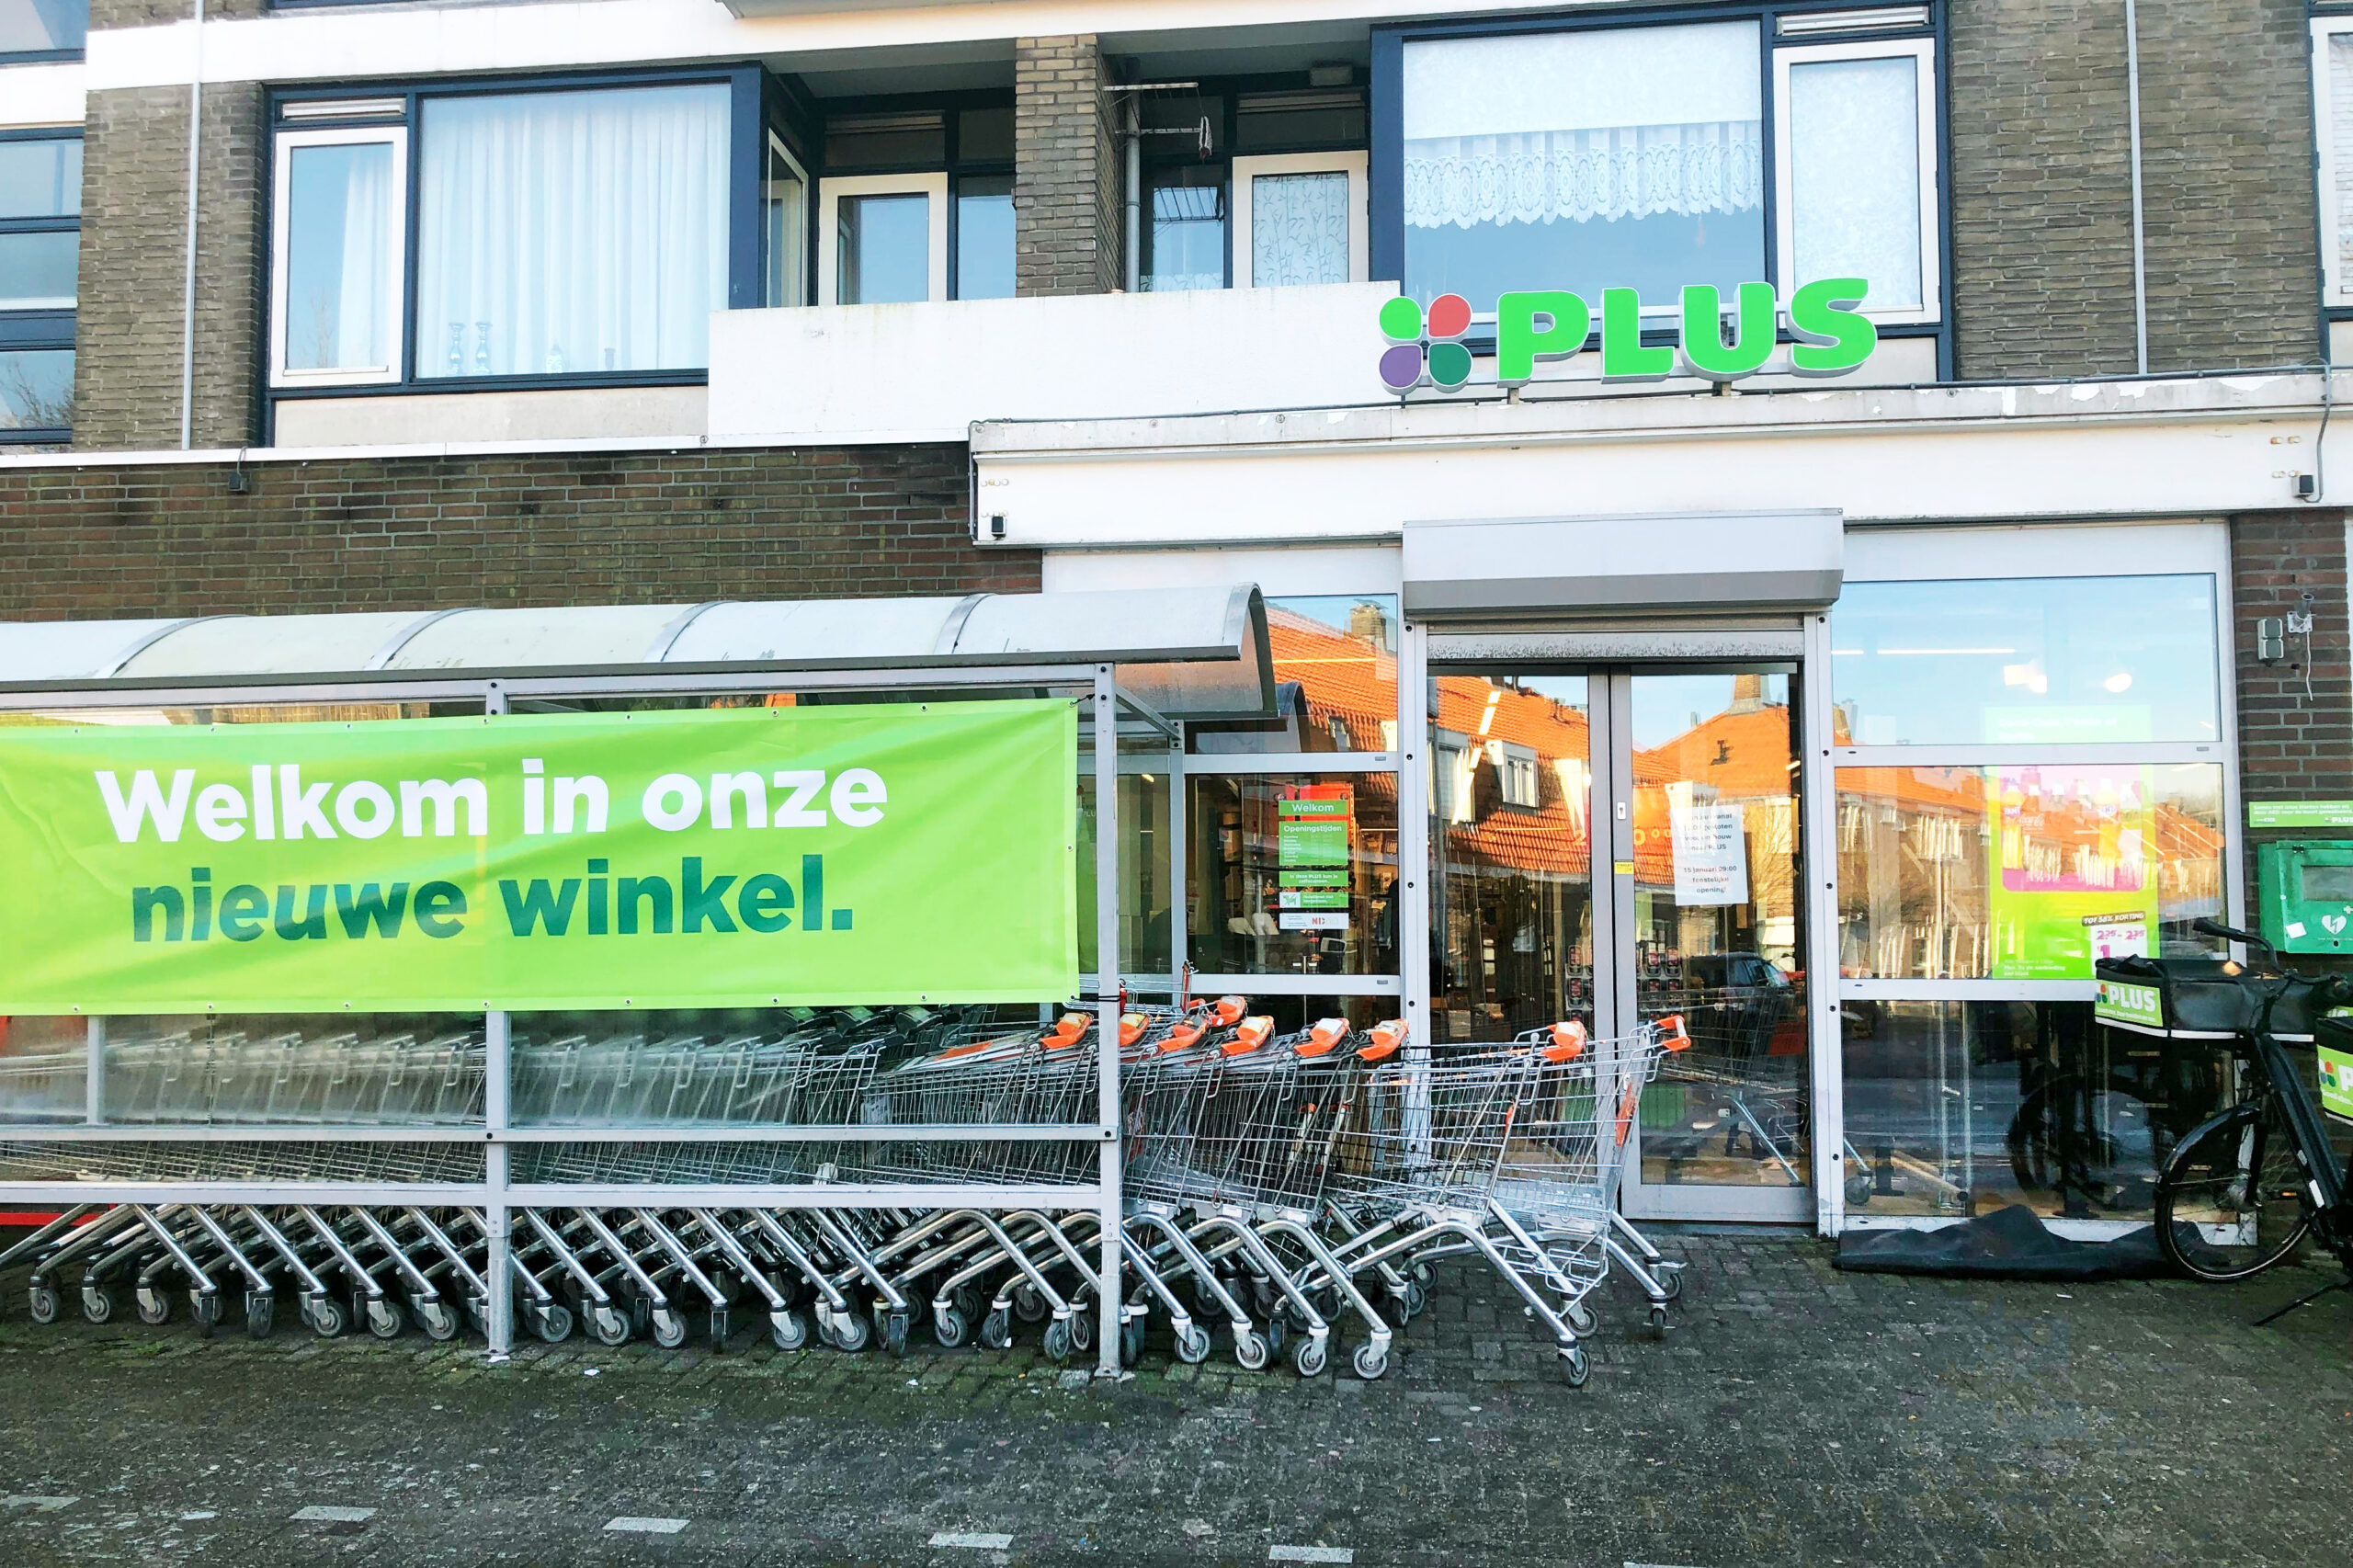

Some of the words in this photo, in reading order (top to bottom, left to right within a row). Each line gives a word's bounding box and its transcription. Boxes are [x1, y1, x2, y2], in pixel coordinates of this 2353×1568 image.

[1496, 278, 1878, 388] PLUS
[95, 764, 488, 843] Welkom
[521, 758, 609, 835] in
[642, 767, 888, 832] onze
[1291, 803, 1335, 812] Welkom
[1692, 866, 1717, 874] januari
[132, 867, 468, 942] nieuwe
[498, 854, 853, 937] winkel.
[2114, 913, 2144, 921] KORTING
[2108, 984, 2156, 1013] PLUS
